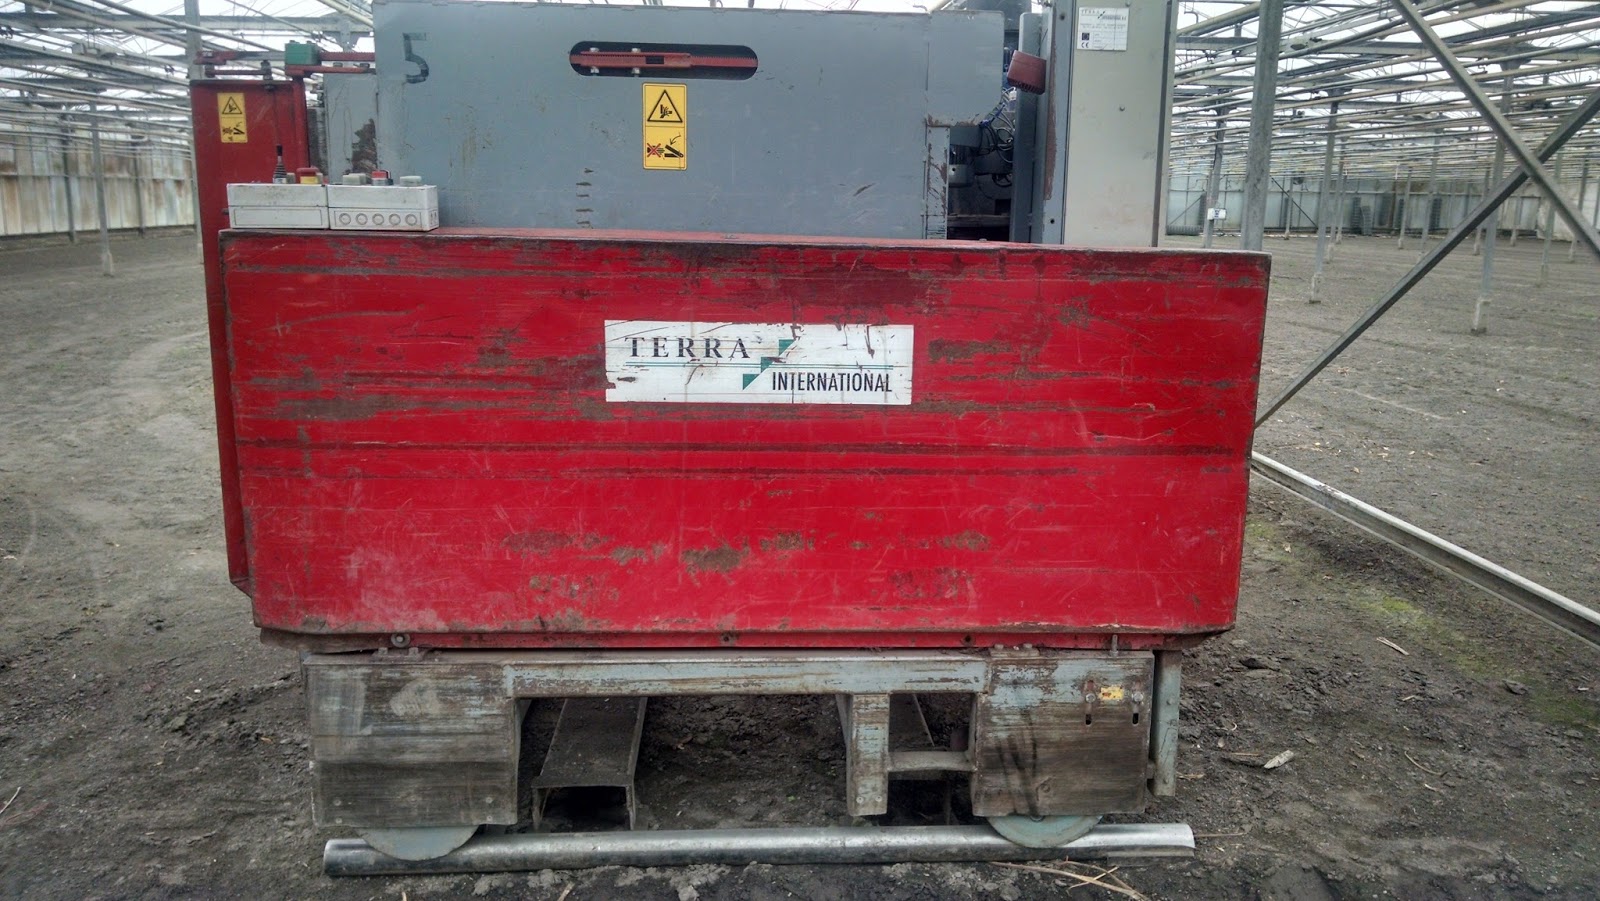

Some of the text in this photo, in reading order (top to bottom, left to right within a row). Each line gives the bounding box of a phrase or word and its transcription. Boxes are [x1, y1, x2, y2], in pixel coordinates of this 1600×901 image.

[402, 32, 429, 84] 5
[624, 336, 751, 359] TERRA
[772, 371, 893, 392] INTERNATIONAL
